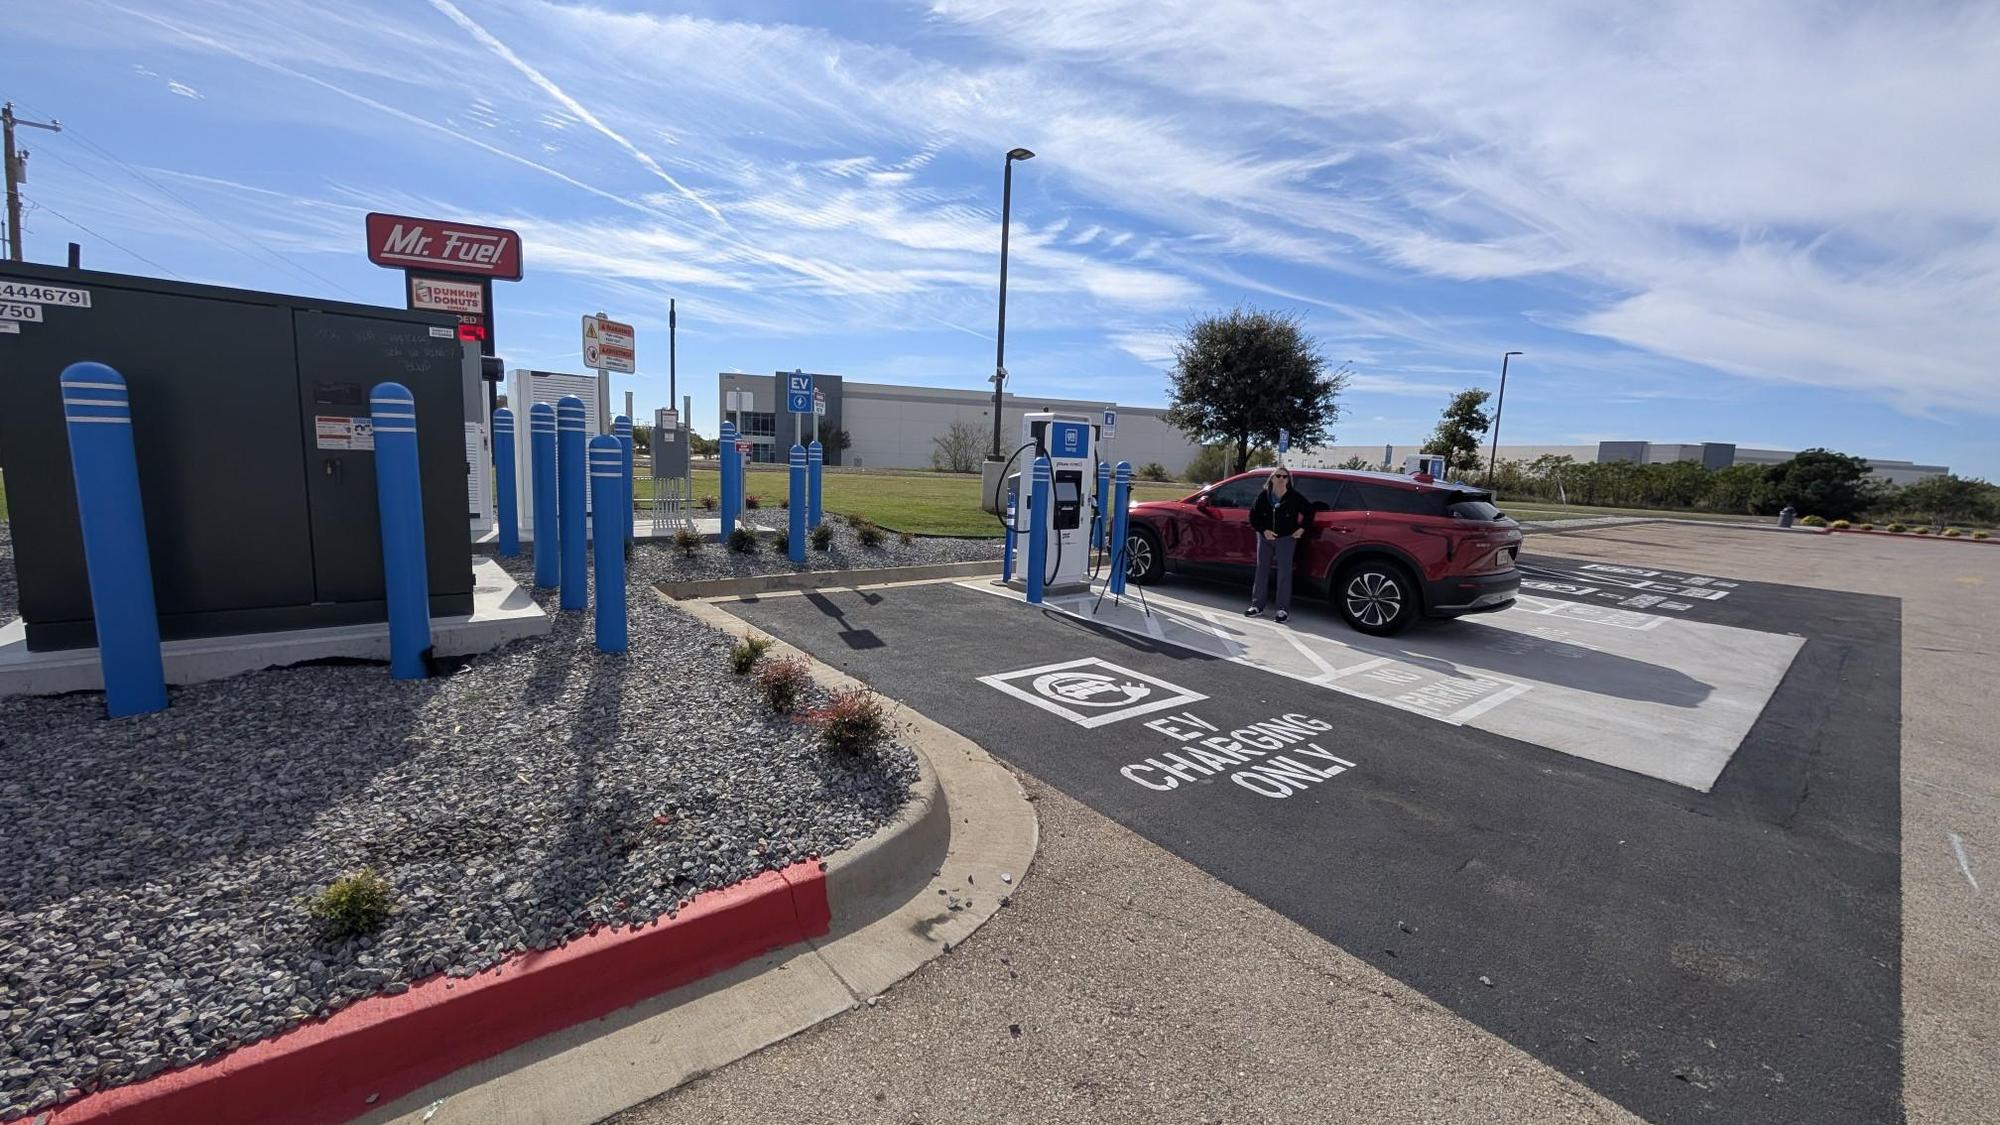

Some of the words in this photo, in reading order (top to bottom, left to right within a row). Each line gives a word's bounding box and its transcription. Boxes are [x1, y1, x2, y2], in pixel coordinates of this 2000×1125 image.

[383, 224, 433, 256] Mr.
[442, 230, 509, 264] Fuel
[0, 285, 81, 304] 444679
[434, 287, 480, 299] DUNKIN'
[434, 296, 479, 307] DONUTS
[791, 377, 809, 390] EV
[1361, 668, 1422, 687] NO
[1143, 711, 1220, 742] EV
[1120, 713, 1333, 791] CHARGING
[1231, 743, 1357, 799] ONLY
